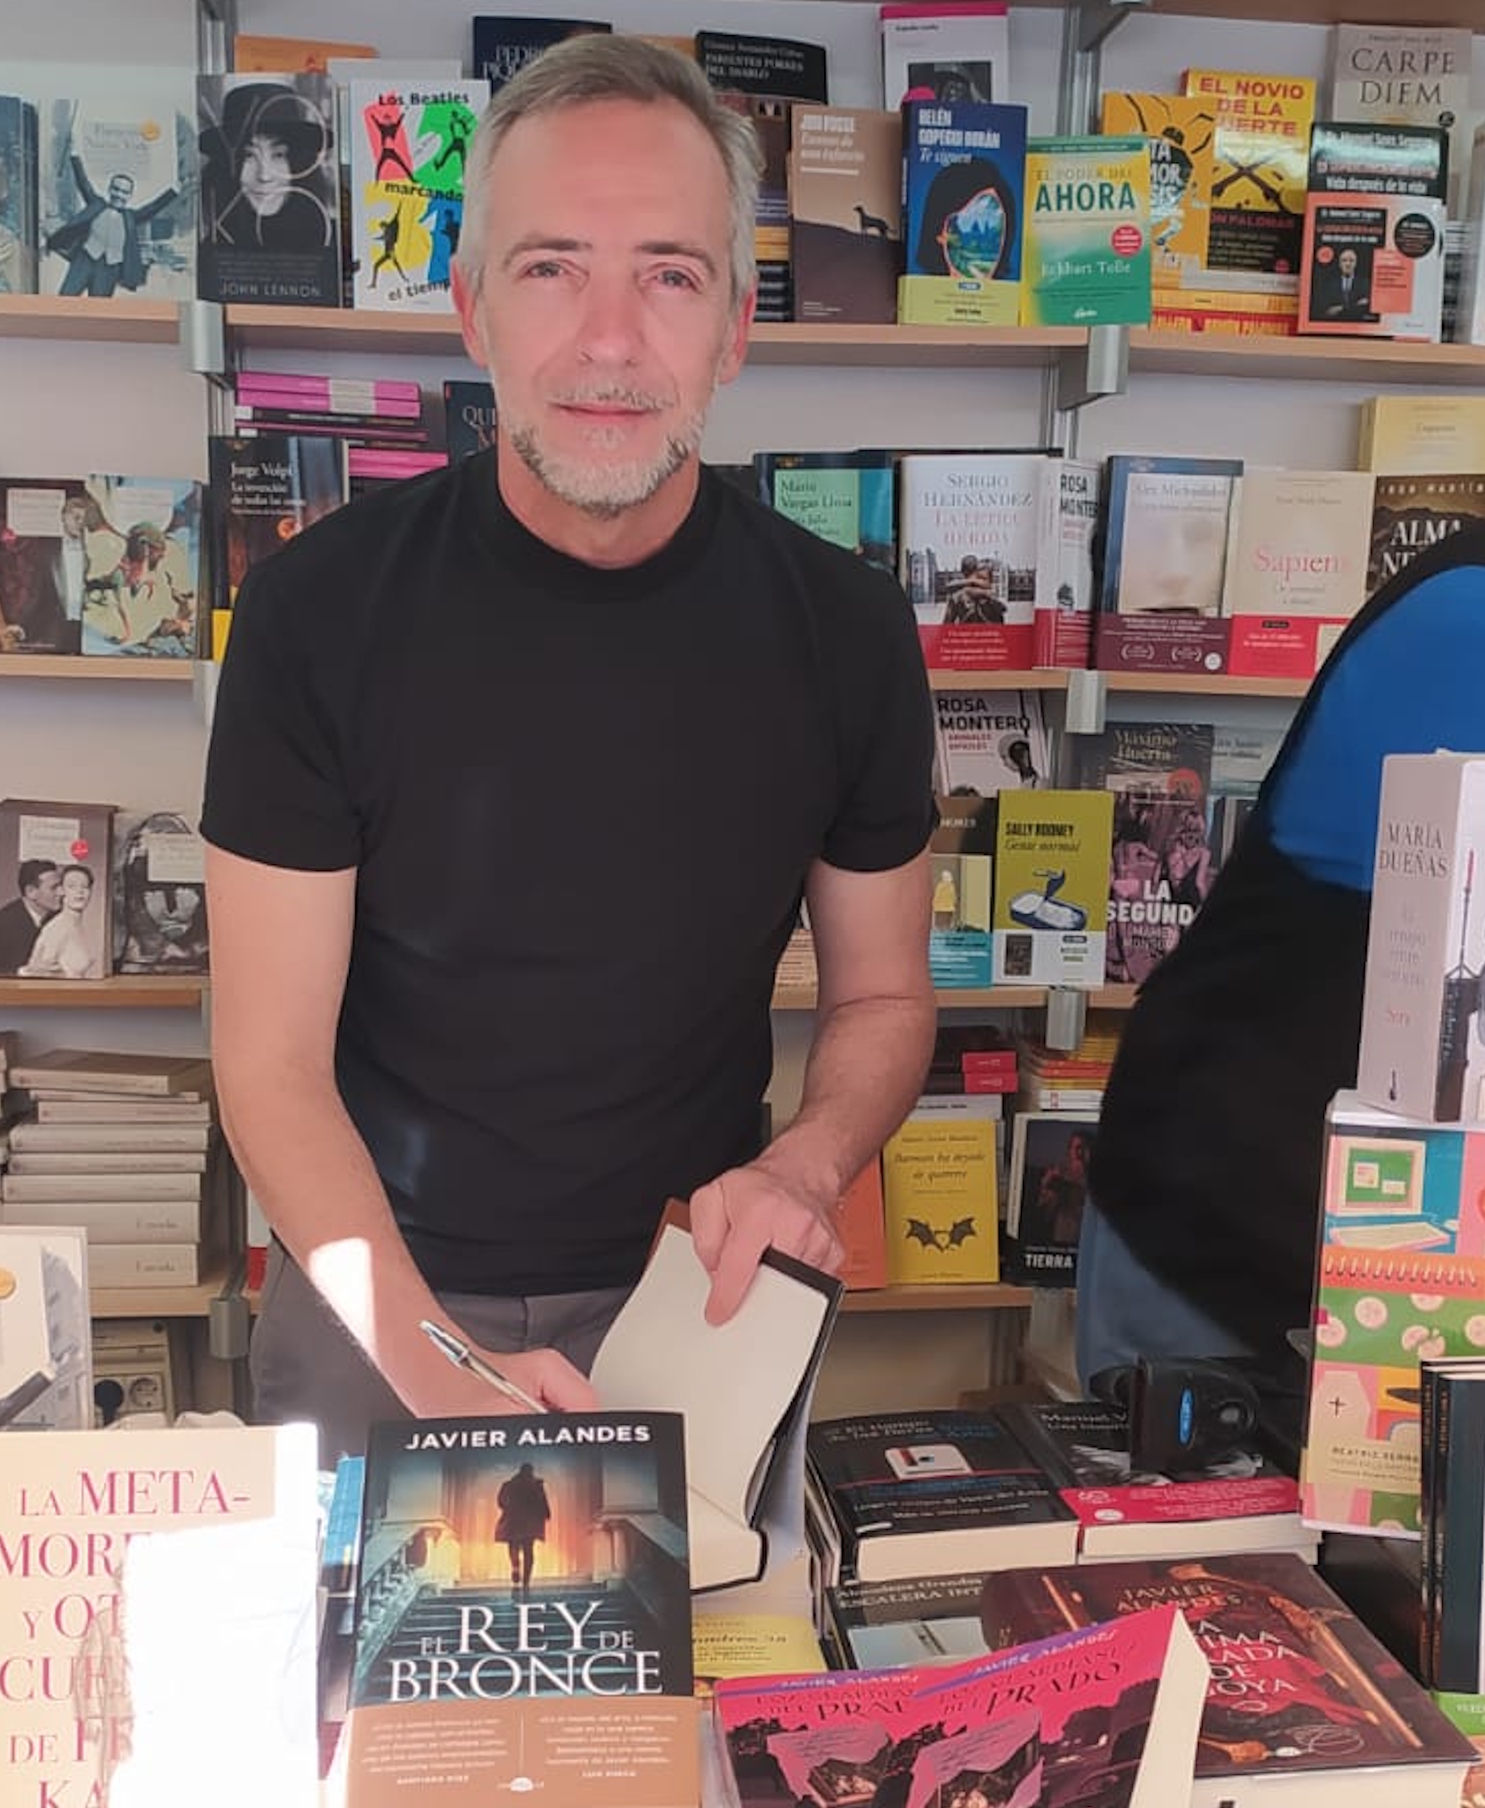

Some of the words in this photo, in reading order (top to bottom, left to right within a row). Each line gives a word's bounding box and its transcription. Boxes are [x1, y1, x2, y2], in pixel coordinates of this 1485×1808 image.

[1351, 47, 1456, 75] CARPE
[378, 93, 404, 106] Los
[410, 91, 470, 105] Beatles
[1199, 77, 1228, 94] EL
[1236, 80, 1304, 100] NOVIO
[1359, 80, 1442, 105] DIEM
[918, 107, 951, 127] BELÉN
[1216, 98, 1247, 116] DE
[1253, 100, 1283, 117] LA
[1217, 117, 1298, 137] UERTE
[1035, 181, 1136, 213] AHORA
[221, 281, 259, 297] JOHN
[263, 282, 323, 298] LENNON
[406, 279, 452, 298] tiemp
[461, 405, 496, 427] QUI
[261, 463, 294, 481] Volpi
[949, 472, 1010, 489] SERGIO
[780, 479, 818, 493] Mario
[1059, 473, 1088, 494] ROSA
[923, 489, 1034, 508] HERNÁNDEZ
[1253, 546, 1350, 583] Sapiens
[936, 698, 988, 713] ROSA
[937, 715, 1031, 731] MONTERO
[1005, 822, 1032, 837] SALLY
[1034, 823, 1074, 837] ROONEY
[1386, 822, 1444, 849] MARÍA
[1038, 839, 1081, 852] normal
[1378, 848, 1448, 879] DUEÑAS
[1142, 879, 1173, 901] LA
[1105, 900, 1195, 927] SEGUND
[405, 1429, 508, 1451] JAVIER
[517, 1425, 652, 1446] ALANDES
[19, 1488, 63, 1517] LA
[77, 1470, 252, 1516] META-
[1123, 1584, 1214, 1600] JAVIER
[22, 1611, 44, 1640] Y
[420, 1636, 450, 1656] EL
[456, 1600, 604, 1654] REY
[599, 1630, 635, 1651] DE
[972, 1652, 1033, 1677] JAVIER
[1038, 1628, 1120, 1660] ALANDES
[388, 1650, 664, 1702] BRONCE
[779, 1678, 838, 1689] JAVIER
[843, 1675, 921, 1685] ALANDES
[986, 1660, 1122, 1716] PRADO
[9, 1733, 59, 1764] DE
